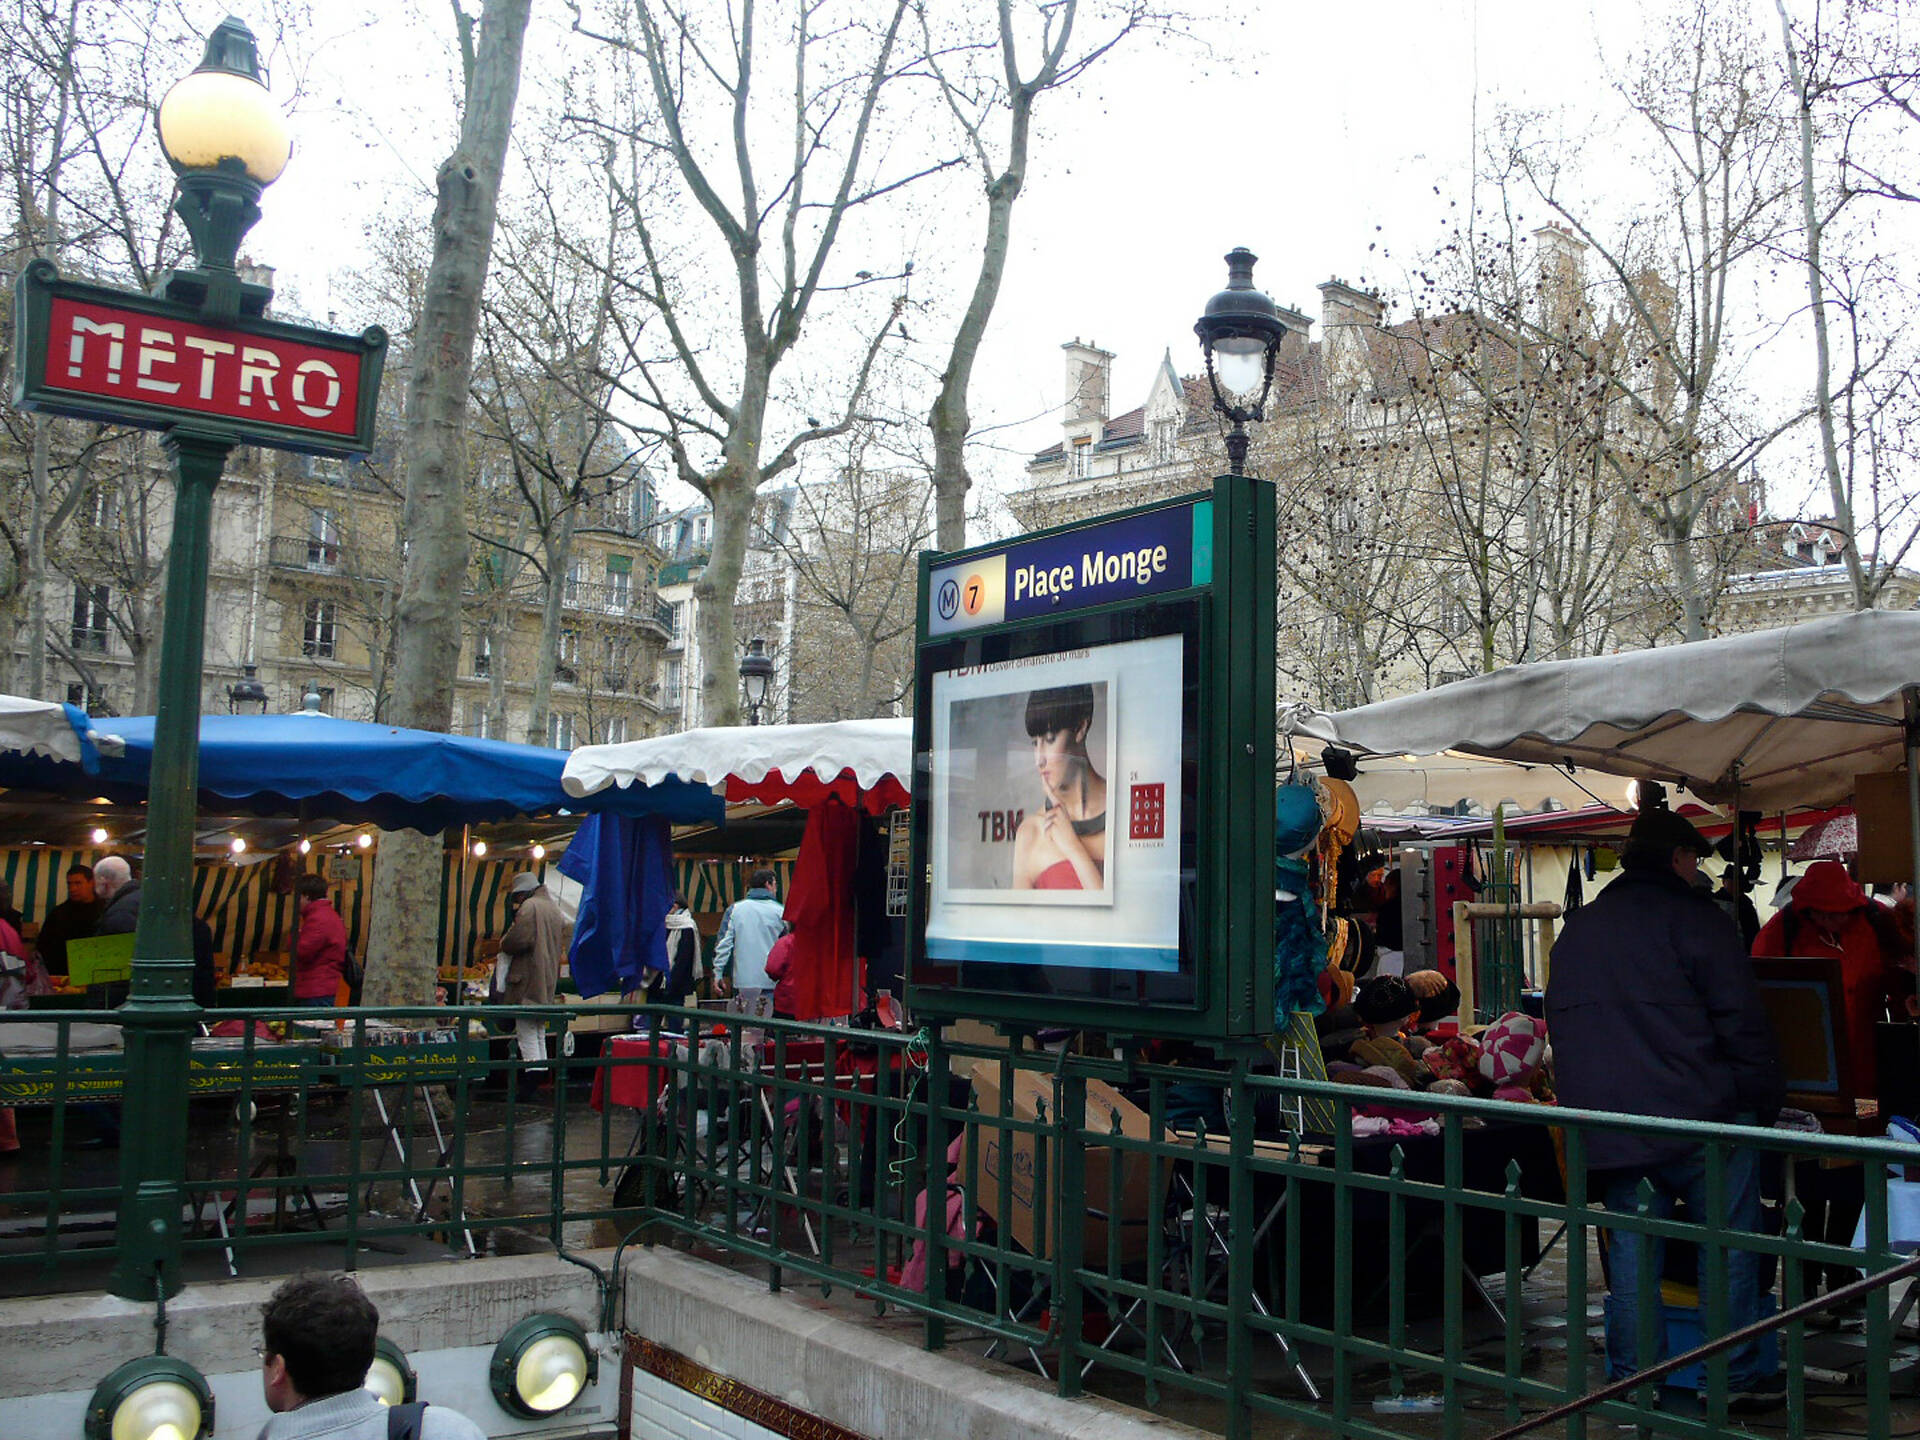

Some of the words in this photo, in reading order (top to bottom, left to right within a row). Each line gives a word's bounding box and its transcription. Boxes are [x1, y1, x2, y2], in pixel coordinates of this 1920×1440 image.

[68, 316, 340, 417] METRO
[1015, 564, 1074, 601] Place
[1082, 544, 1168, 586] Monge
[969, 585, 978, 609] 7
[978, 808, 1024, 842] TBM
